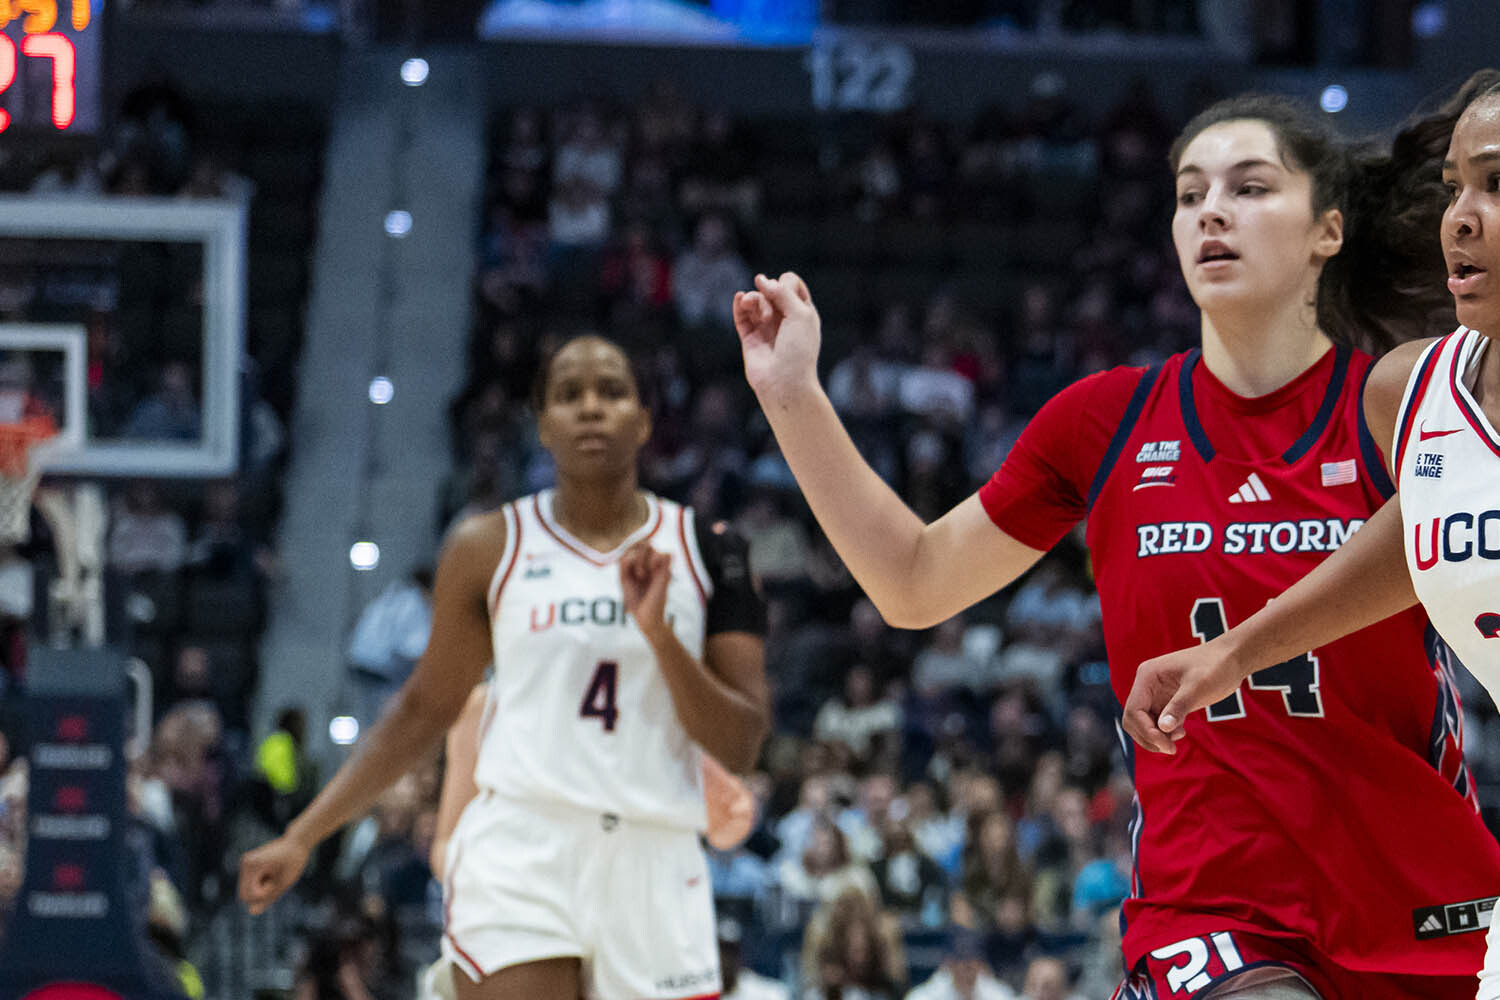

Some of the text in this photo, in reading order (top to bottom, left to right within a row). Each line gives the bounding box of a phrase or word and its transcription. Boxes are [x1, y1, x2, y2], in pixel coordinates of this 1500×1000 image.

[0, 30, 77, 132] 7
[804, 38, 913, 111] 122
[1136, 450, 1181, 463] CHANGE
[1158, 440, 1181, 452] THE
[1424, 453, 1444, 466] THE
[1137, 518, 1368, 558] RED STORM
[580, 661, 619, 733] 4
